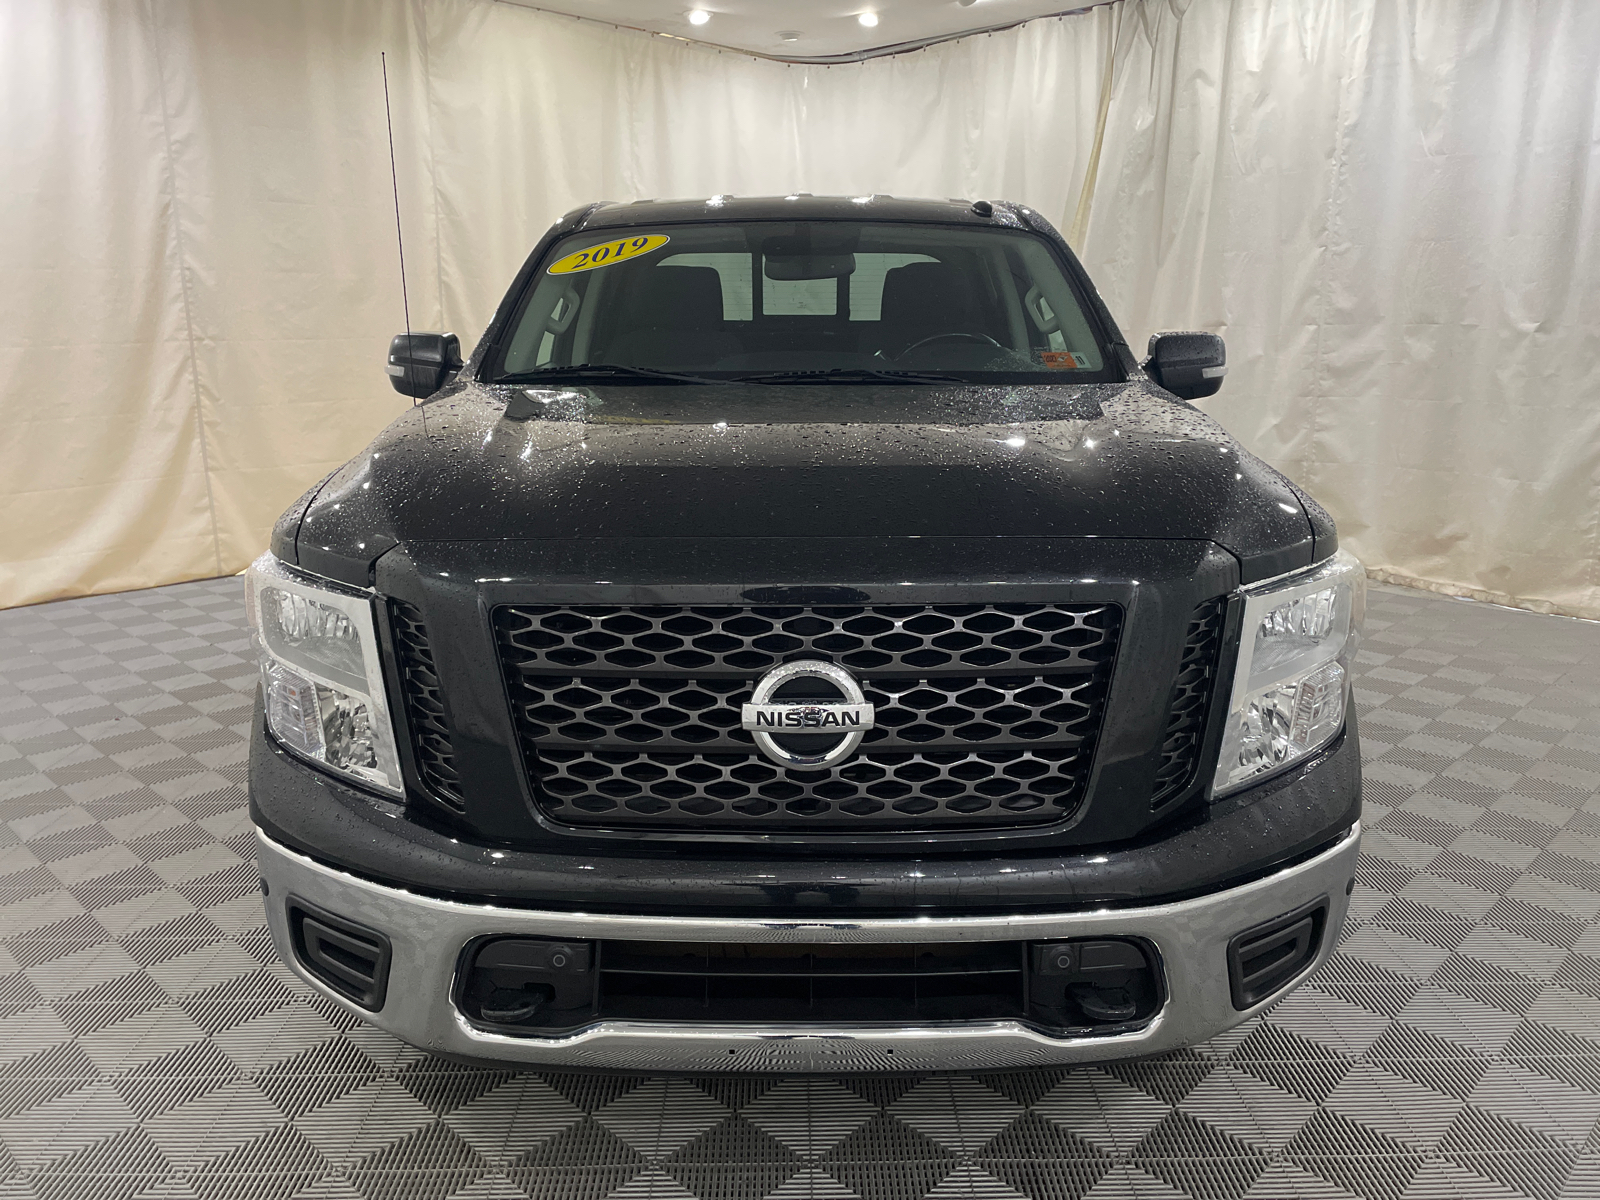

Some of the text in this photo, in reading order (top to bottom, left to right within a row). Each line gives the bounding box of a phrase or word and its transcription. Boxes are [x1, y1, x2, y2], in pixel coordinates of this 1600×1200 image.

[571, 236, 649, 270] 2019
[1075, 355, 1086, 365] 11
[756, 710, 860, 728] NISSAN
